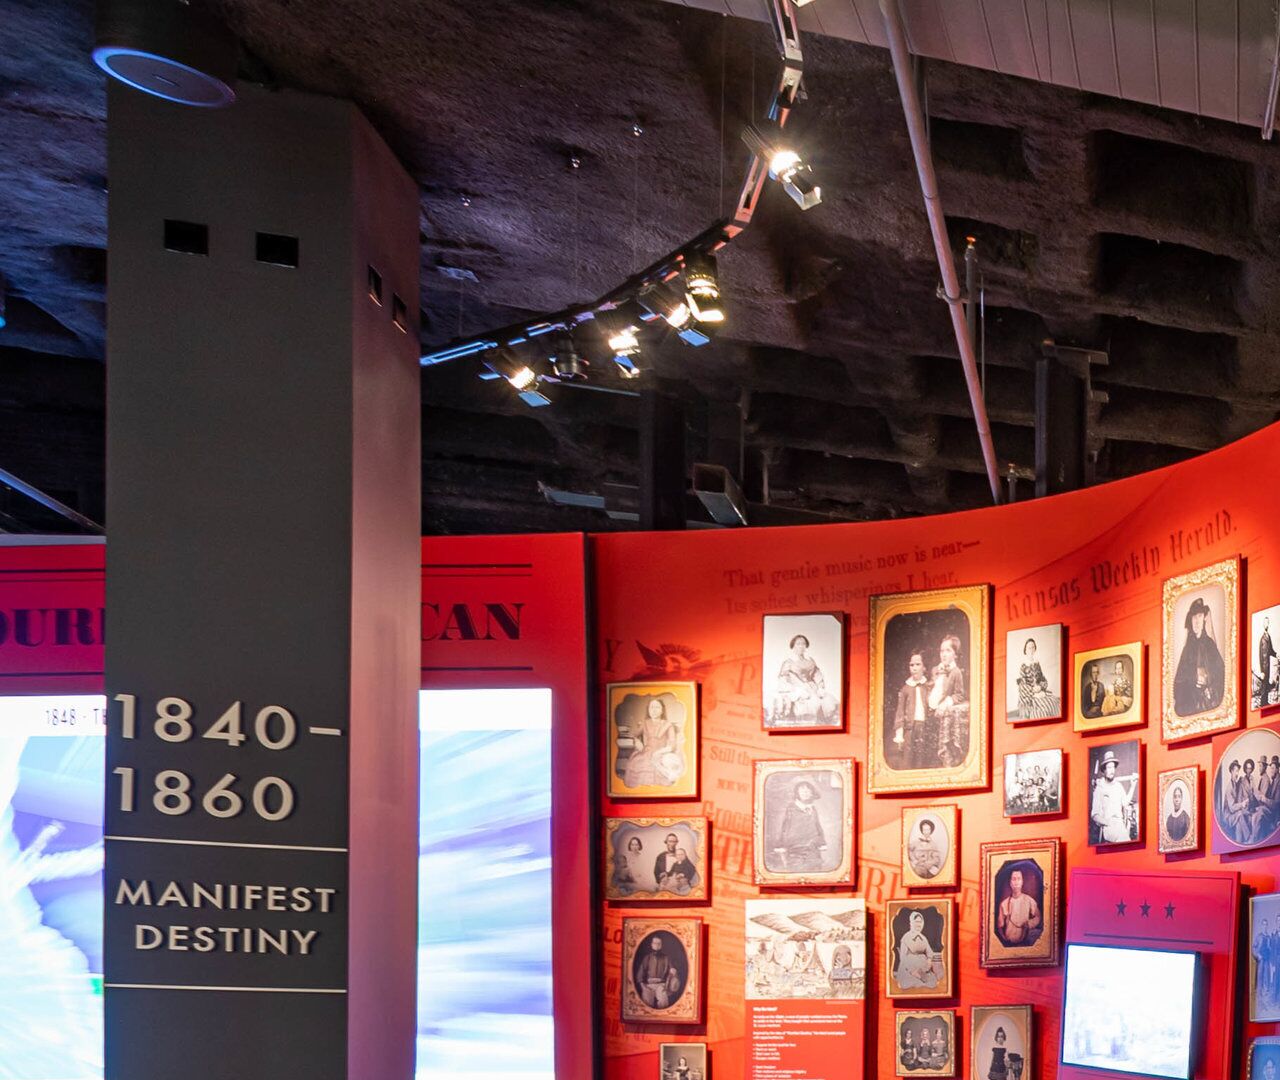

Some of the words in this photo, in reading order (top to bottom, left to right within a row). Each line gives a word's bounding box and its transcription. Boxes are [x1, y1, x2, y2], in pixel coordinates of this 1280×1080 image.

[723, 568, 764, 588] That
[770, 561, 821, 587] gentle
[825, 553, 874, 577] music
[876, 553, 909, 569] now
[914, 544, 927, 563] is
[1006, 574, 1081, 622] Kansas
[1090, 545, 1161, 593] Weekly
[45, 708, 76, 726] 1848
[112, 766, 294, 822] 1860
[114, 878, 336, 914] MANIFEST
[134, 924, 318, 956] DESTINY
